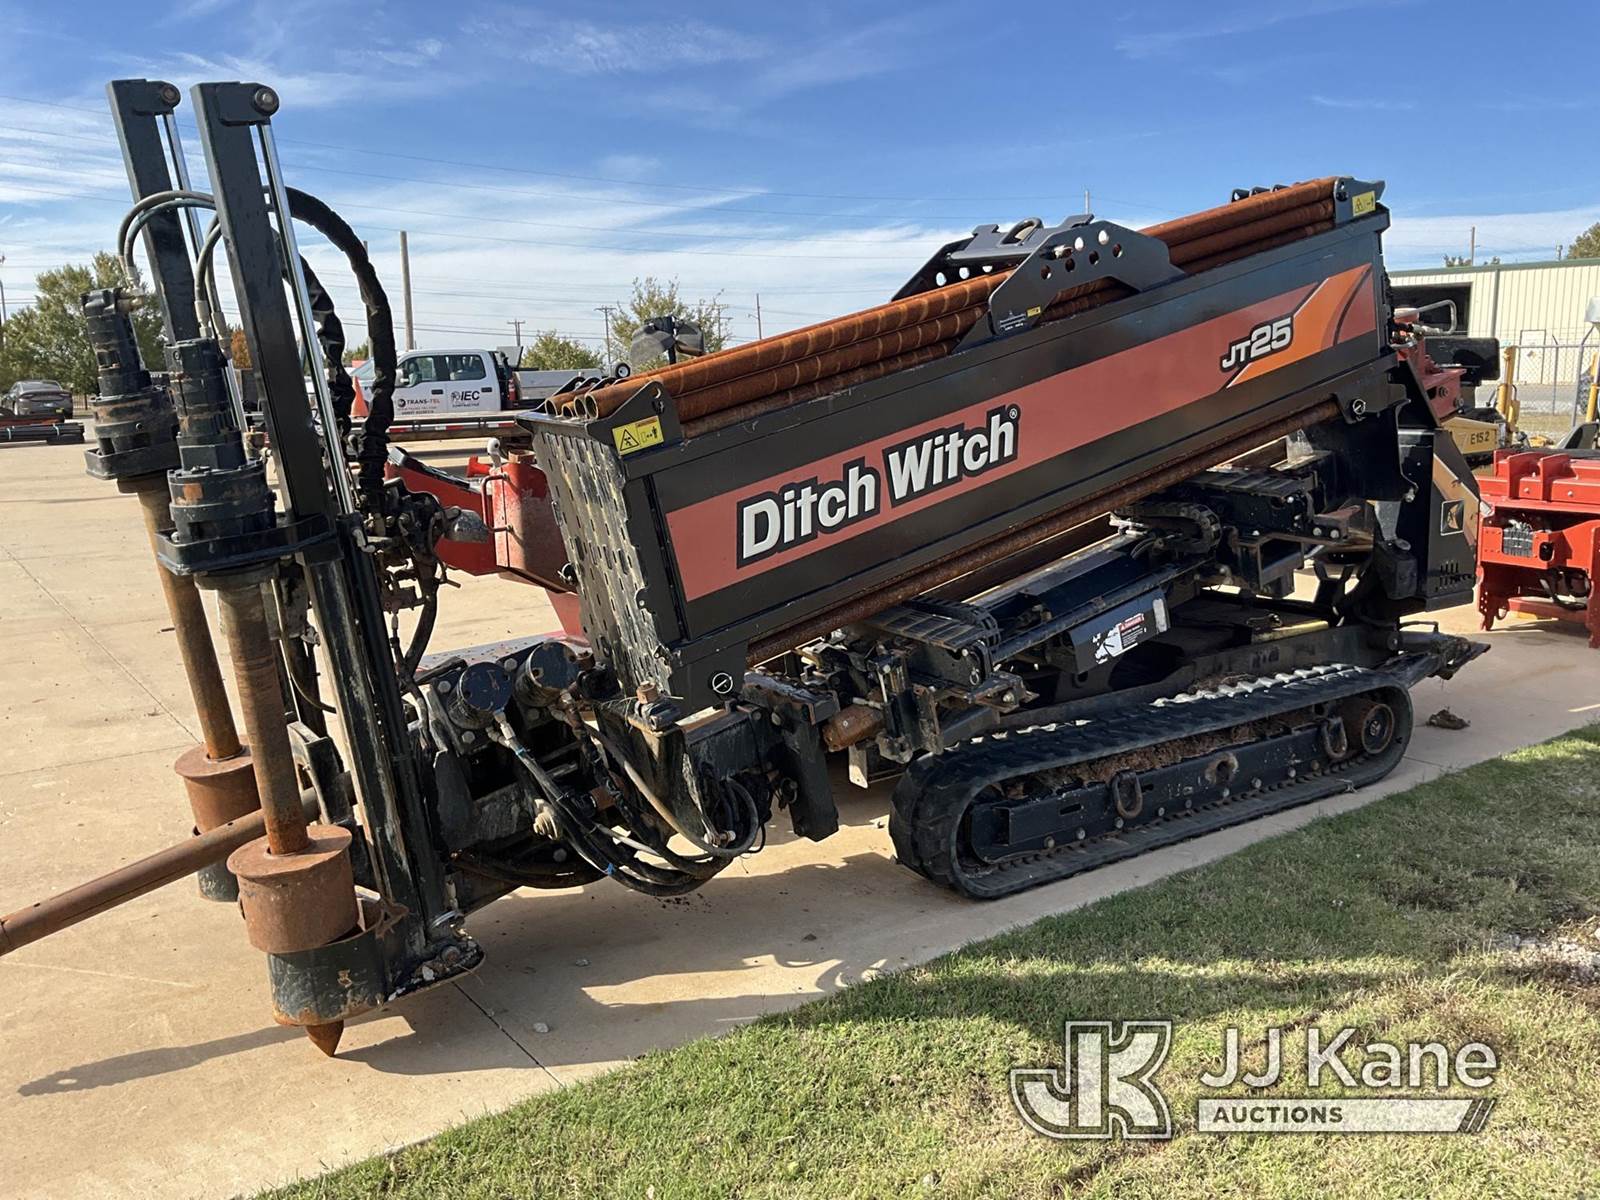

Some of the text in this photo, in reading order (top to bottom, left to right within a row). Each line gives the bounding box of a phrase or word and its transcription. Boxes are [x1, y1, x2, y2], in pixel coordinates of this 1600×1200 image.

[1222, 317, 1292, 369] JT25
[460, 390, 480, 401] IEC
[742, 466, 876, 559] Ditch
